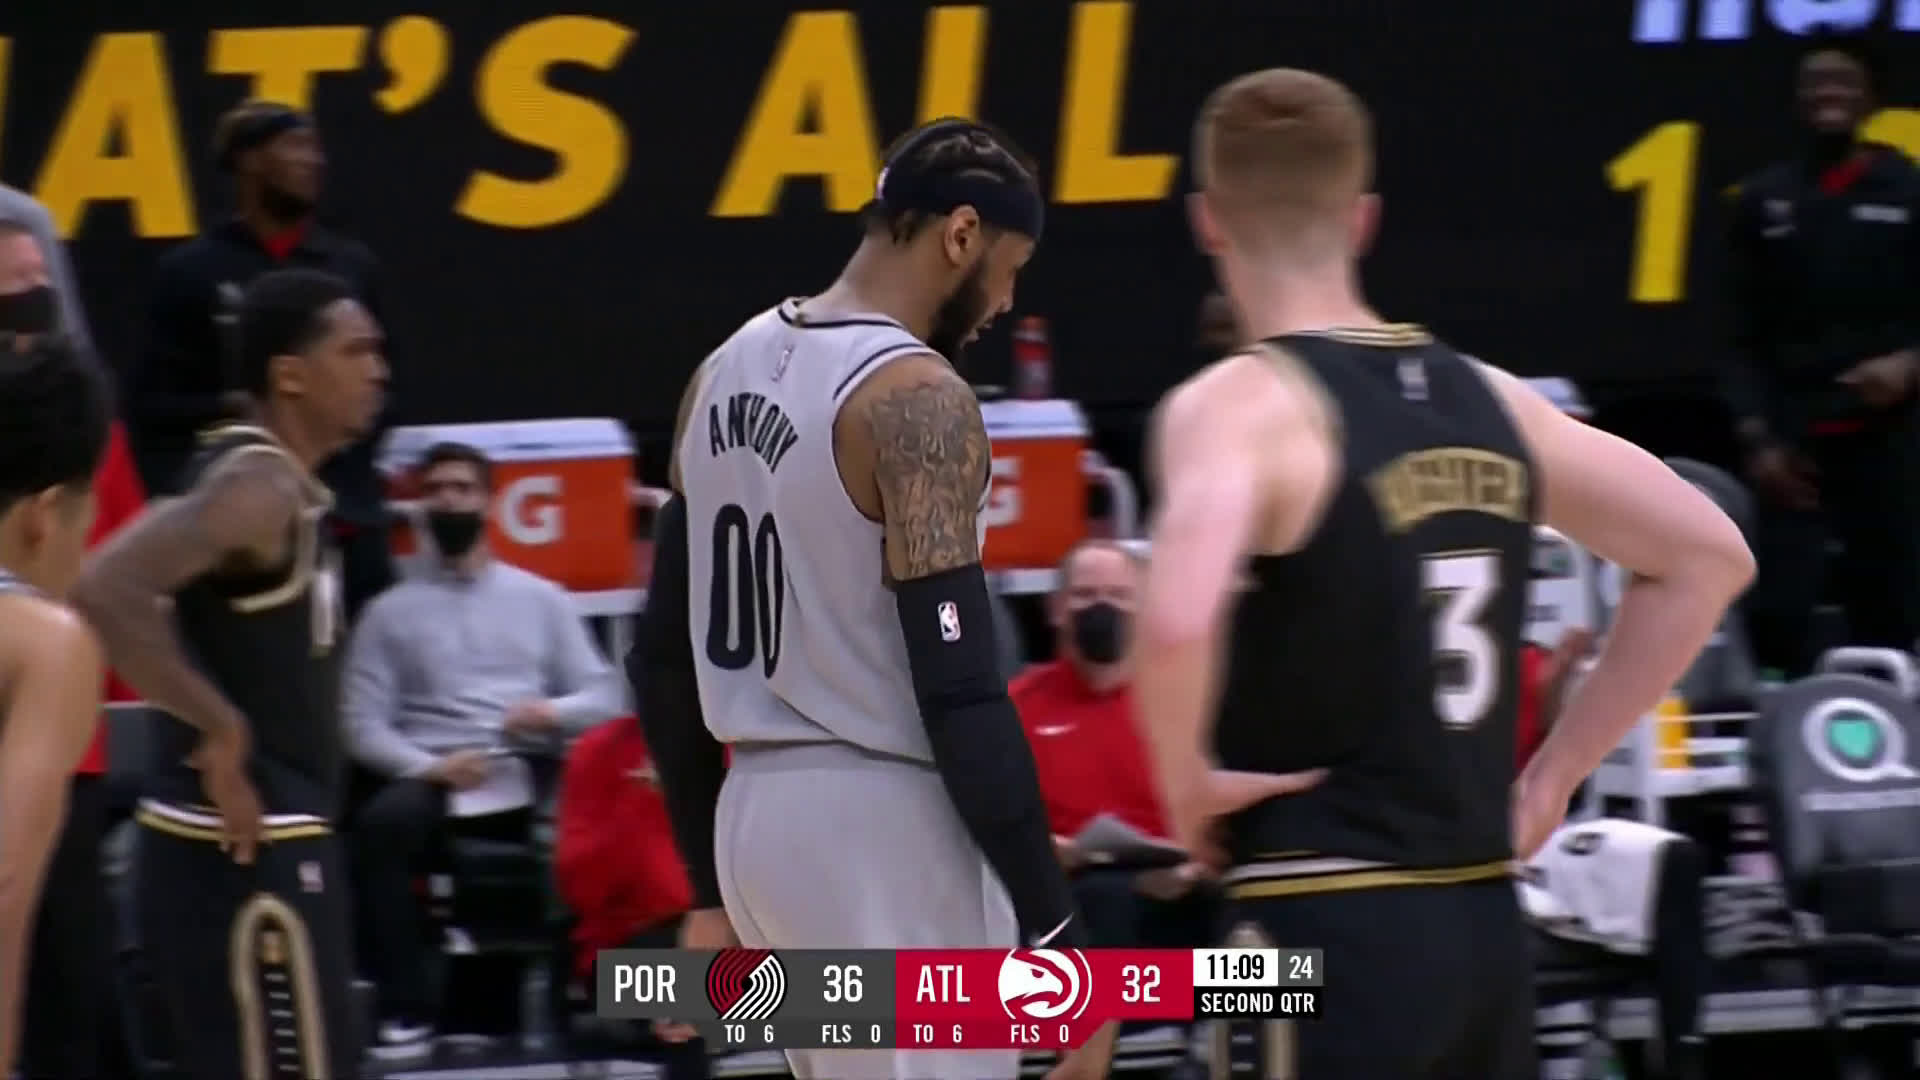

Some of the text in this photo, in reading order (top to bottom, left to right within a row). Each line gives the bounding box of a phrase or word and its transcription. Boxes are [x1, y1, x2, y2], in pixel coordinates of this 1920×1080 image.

[0, 14, 636, 238] AT'S
[500, 475, 565, 546] G
[705, 503, 785, 680] 00
[1418, 552, 1502, 730] 3
